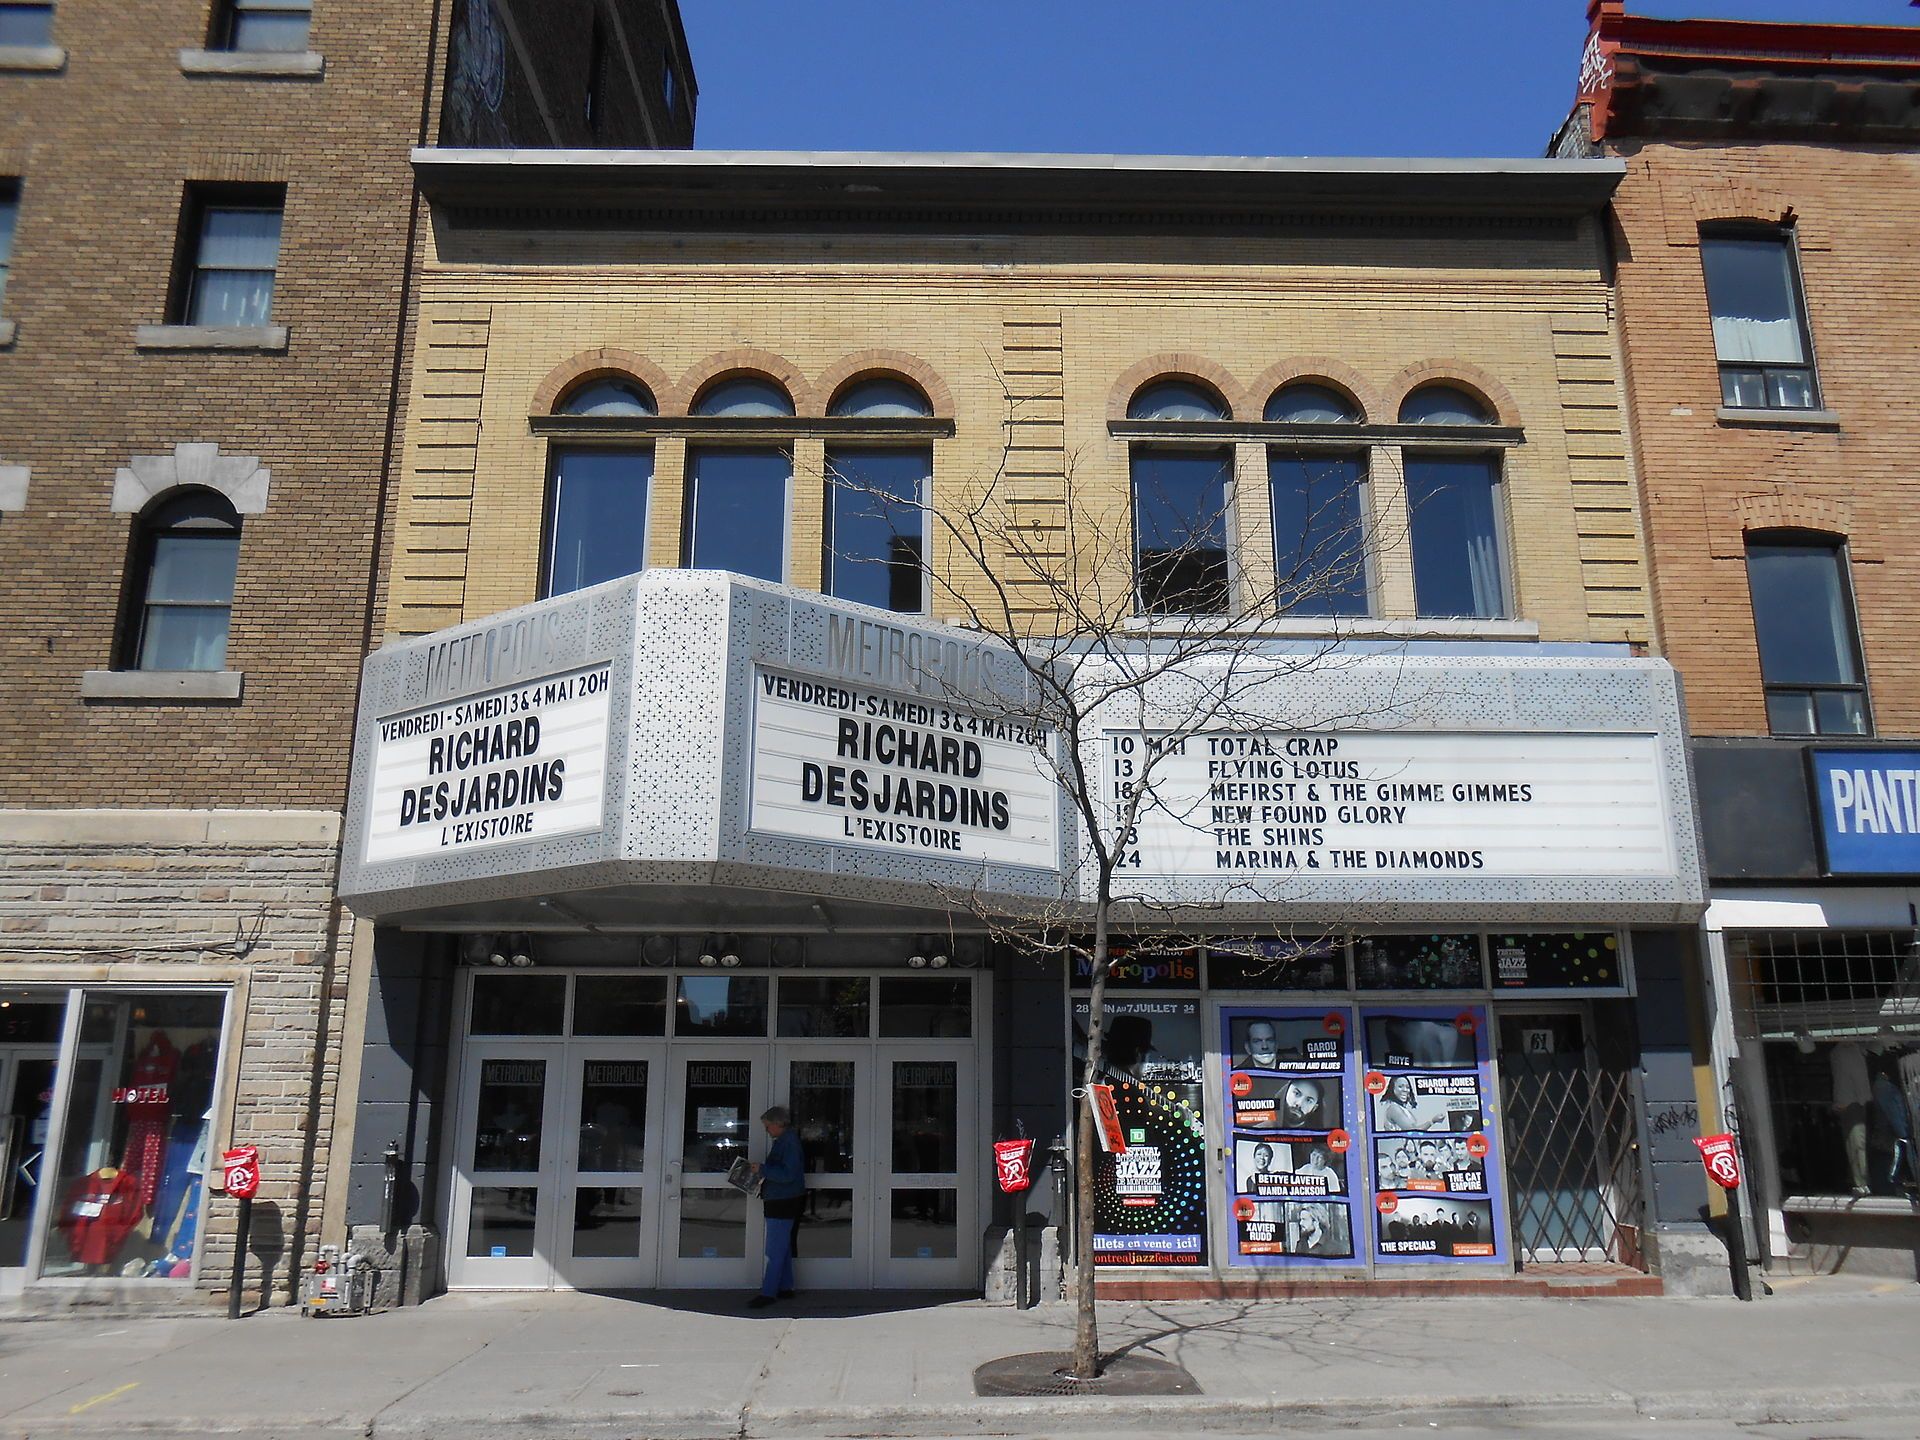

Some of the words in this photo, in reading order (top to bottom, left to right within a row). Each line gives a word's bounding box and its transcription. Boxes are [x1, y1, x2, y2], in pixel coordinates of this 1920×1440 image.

[425, 611, 560, 699] METROPOLIS
[828, 613, 996, 698] METROPOLIS
[382, 716, 444, 742] VENDREDI
[455, 695, 508, 726] SAMEDI
[510, 693, 519, 713] 3
[521, 690, 530, 711] &
[532, 687, 542, 707] 4
[544, 679, 574, 705] MAI
[579, 670, 609, 697] 20H
[939, 708, 949, 730] 3
[953, 711, 964, 733] &
[967, 715, 977, 735] 4
[982, 718, 1013, 742] MAI
[429, 715, 541, 775] RICHARD
[837, 717, 982, 779] RICHARD
[1113, 736, 1135, 754] 10
[1208, 738, 1275, 756] TOTAL
[1286, 738, 1339, 756] CRAP
[1114, 759, 1134, 777] 13
[1208, 761, 1283, 778] FLYING
[1295, 761, 1360, 779] LOTUS
[400, 758, 566, 827] DESJARDINS
[802, 761, 1010, 831] DESJARDINS
[1307, 784, 1320, 801] &
[1330, 784, 1367, 801] THE
[1377, 784, 1445, 802] GIMME
[1452, 784, 1532, 802] GIMMES
[1212, 805, 1252, 823] NEW
[1262, 805, 1327, 823] FOUND
[1338, 806, 1407, 824] GLORY
[441, 812, 534, 847] L'EXISTOIRE
[844, 815, 962, 851] L'EXISTOIRE
[1214, 828, 1251, 846] THE
[1264, 828, 1324, 846] SHINS
[1217, 850, 1297, 868] MARINA
[1307, 850, 1320, 868] &
[1330, 851, 1367, 868] THE
[1375, 851, 1484, 869] DIAMONDS
[1076, 958, 1196, 983] Mtropolis
[1076, 1004, 1090, 1013] 28
[1307, 1041, 1337, 1052] GAROU
[1389, 1055, 1410, 1066] RHYE
[486, 1064, 545, 1082] METROPOLIS
[588, 1065, 646, 1083] METROPOLIS
[690, 1066, 748, 1084] METROPOLIS
[1417, 1078, 1449, 1088] SHARON
[1450, 1077, 1475, 1087] JONES
[1237, 1100, 1275, 1110] WOODKID
[1116, 1161, 1162, 1178] JAZZ
[1448, 1173, 1463, 1183] THE
[1465, 1172, 1481, 1182] CAT
[1258, 1174, 1288, 1184] BETTYE
[1290, 1175, 1325, 1185] LAVETTE
[1450, 1181, 1482, 1191] EMPIRE
[1258, 1186, 1288, 1195] WANDA
[1289, 1186, 1326, 1196] JACKSON
[1246, 1222, 1276, 1233] XAVIER
[1250, 1231, 1272, 1241] RUDD
[1093, 1238, 1125, 1249] illets
[1128, 1241, 1140, 1249] en
[1144, 1240, 1173, 1249] vente
[1381, 1242, 1397, 1252] THE
[1397, 1240, 1437, 1251] SPECIALS
[1095, 1252, 1198, 1265] ontrealjazzfest.com
